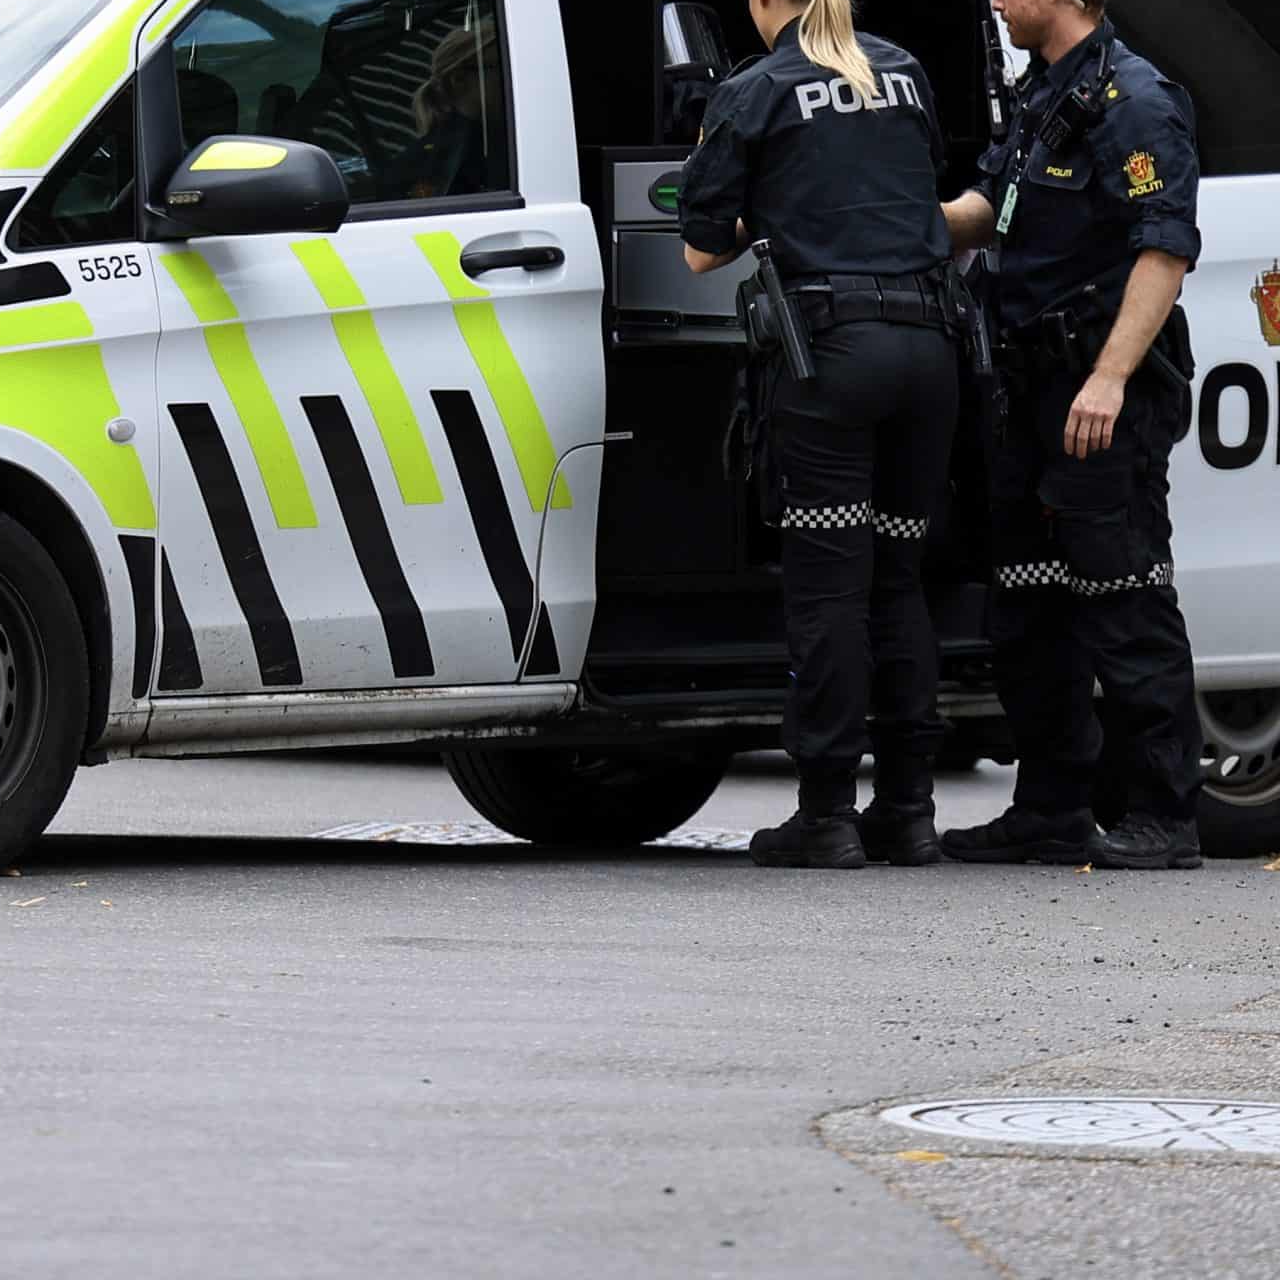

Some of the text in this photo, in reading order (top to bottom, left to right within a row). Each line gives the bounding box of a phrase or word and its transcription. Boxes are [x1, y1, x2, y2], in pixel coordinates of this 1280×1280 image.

[1046, 166, 1073, 178] POLITI
[1128, 179, 1164, 199] POLITI
[78, 254, 142, 282] 5525
